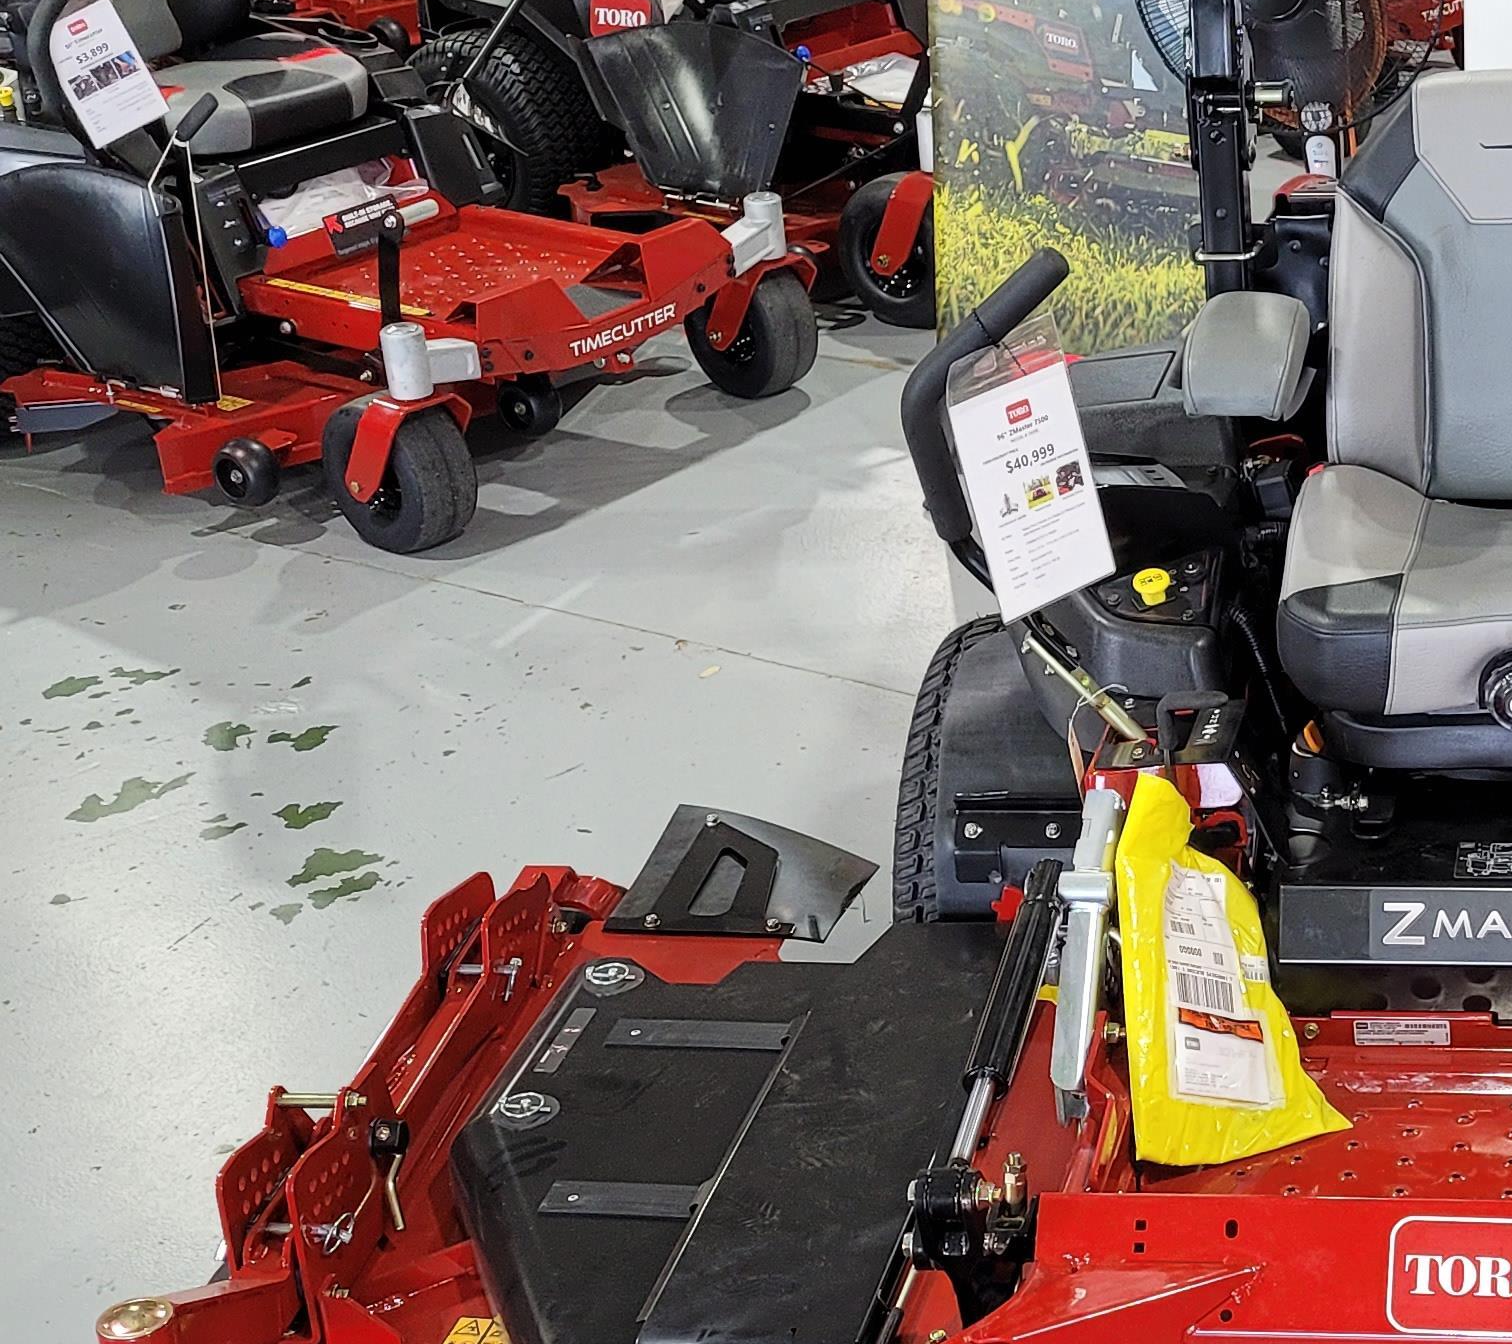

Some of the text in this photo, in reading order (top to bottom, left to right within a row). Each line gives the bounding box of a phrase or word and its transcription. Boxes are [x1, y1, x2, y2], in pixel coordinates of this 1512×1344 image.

[594, 8, 647, 27] TORO
[75, 42, 110, 64] $3,899
[1046, 32, 1077, 48] TORO
[569, 303, 676, 357] TIMECUTTER
[1005, 443, 1055, 474] $40,999
[1382, 902, 1426, 946] Z
